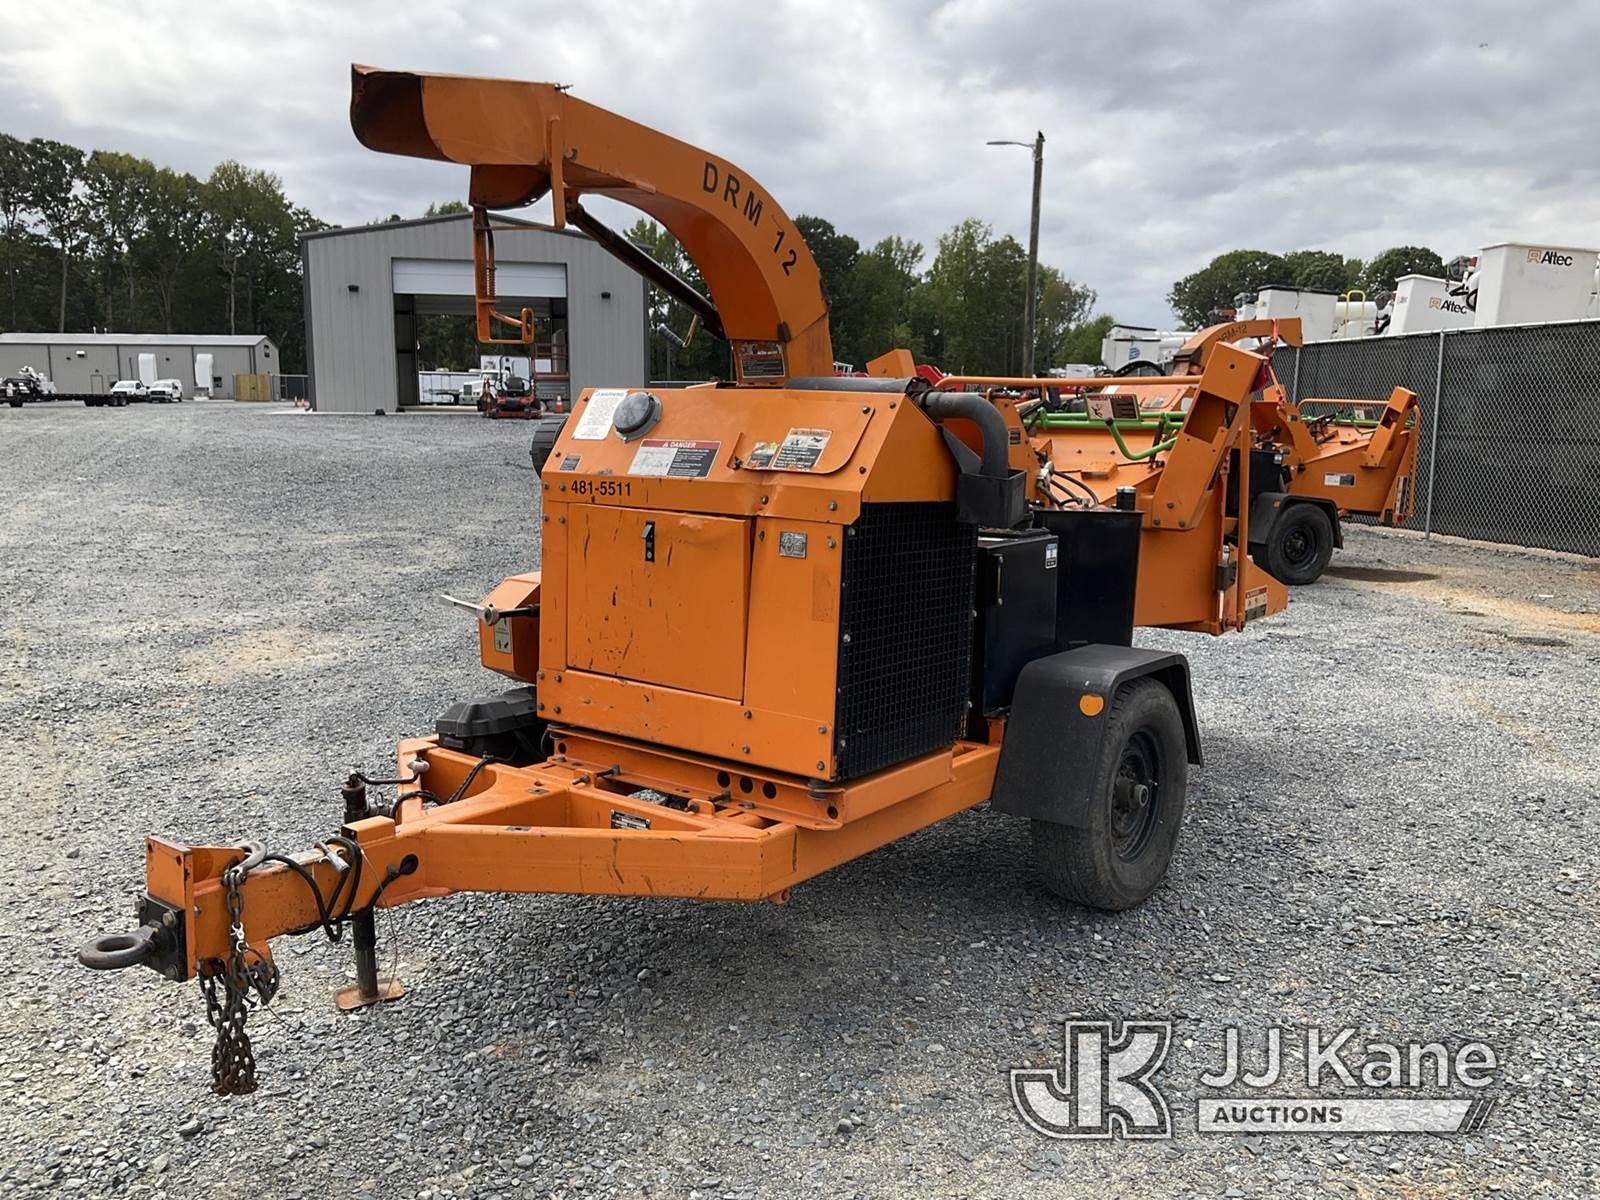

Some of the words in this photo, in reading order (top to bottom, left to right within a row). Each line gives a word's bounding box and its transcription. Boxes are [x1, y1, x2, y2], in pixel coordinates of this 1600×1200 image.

[703, 161, 764, 227] DRM
[773, 231, 797, 276] 12
[1541, 251, 1573, 267] Altec
[1440, 299, 1467, 315] Altec
[669, 441, 697, 449] DANGER
[571, 480, 631, 497] 481-5511
